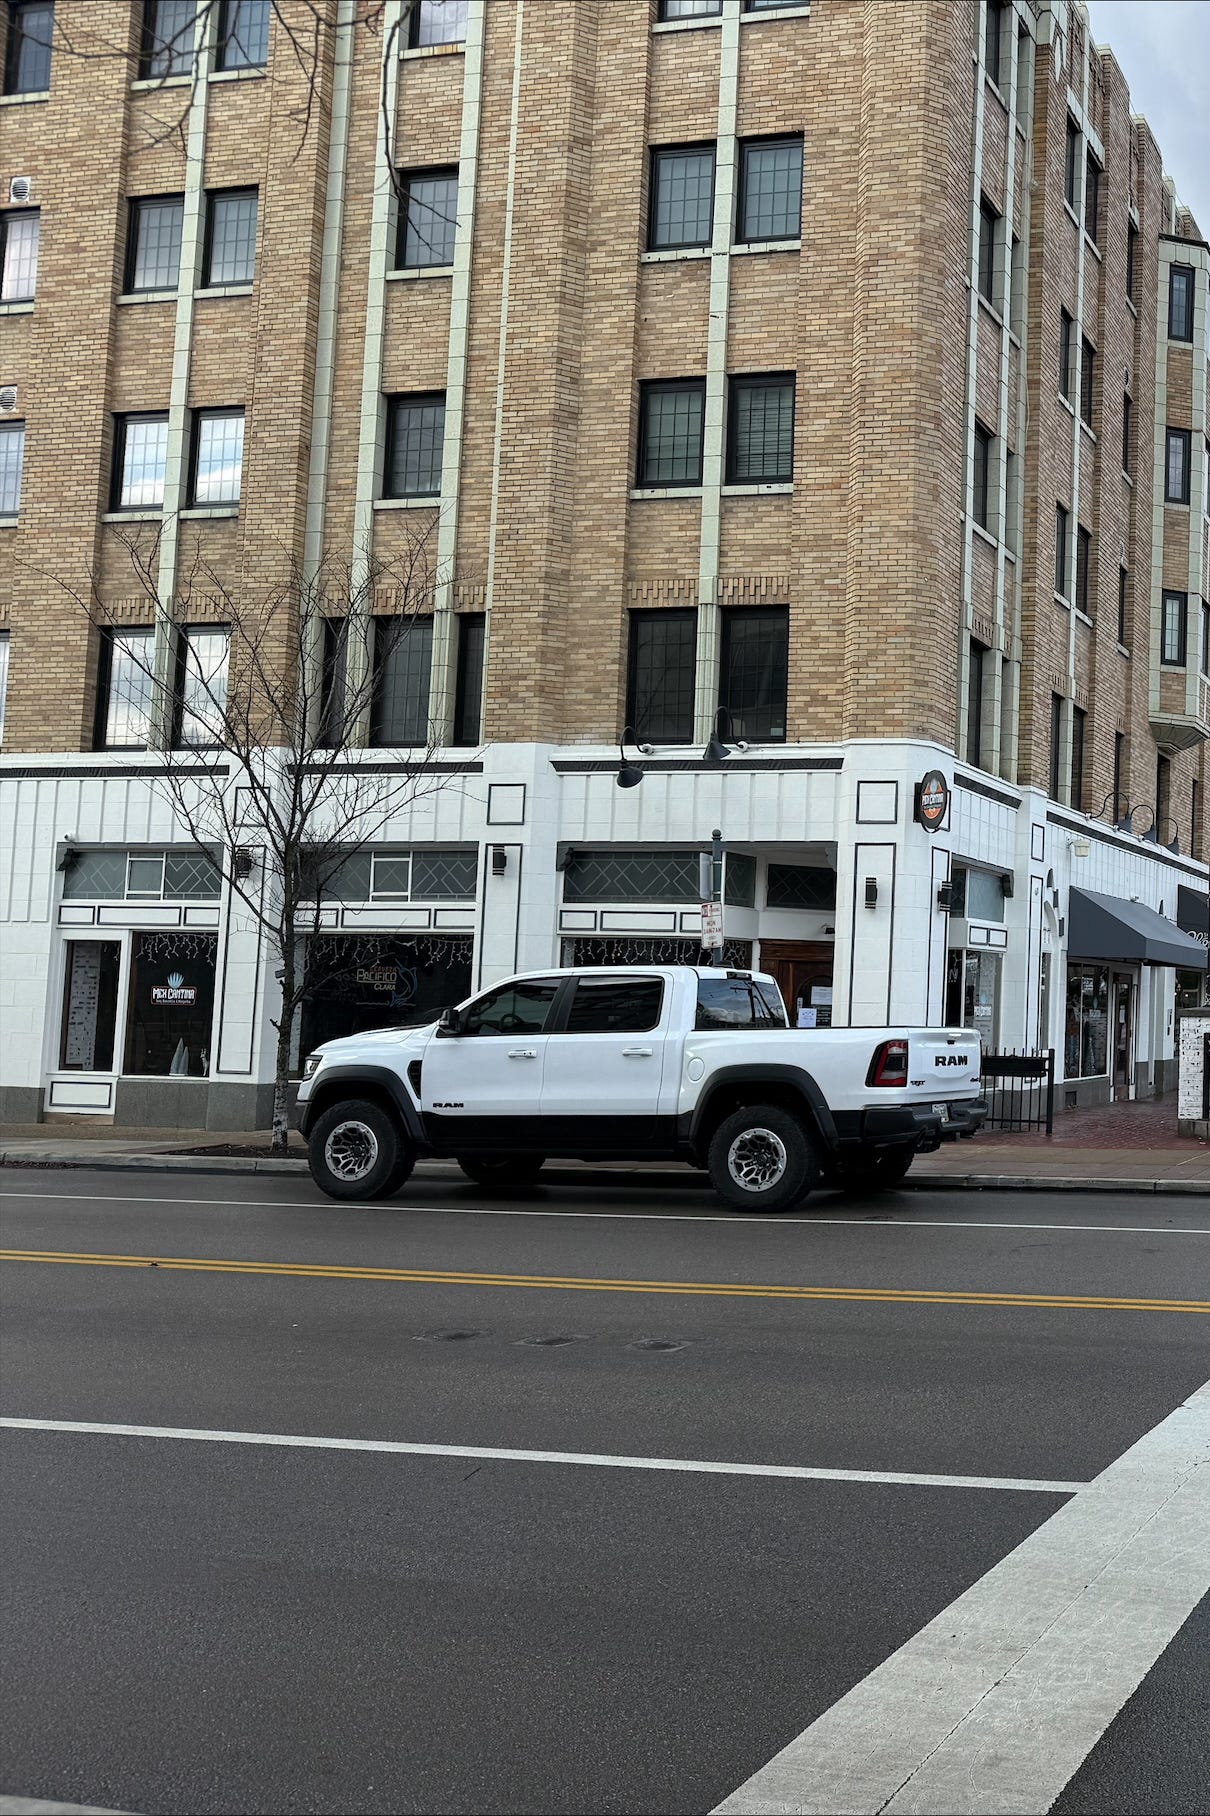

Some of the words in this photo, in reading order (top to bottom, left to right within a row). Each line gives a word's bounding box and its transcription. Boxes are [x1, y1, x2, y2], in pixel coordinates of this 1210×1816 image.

[357, 969, 397, 982] PACIFICO
[152, 988, 167, 999] MEX
[168, 988, 195, 999] CANTINA
[935, 1056, 968, 1066] RAM
